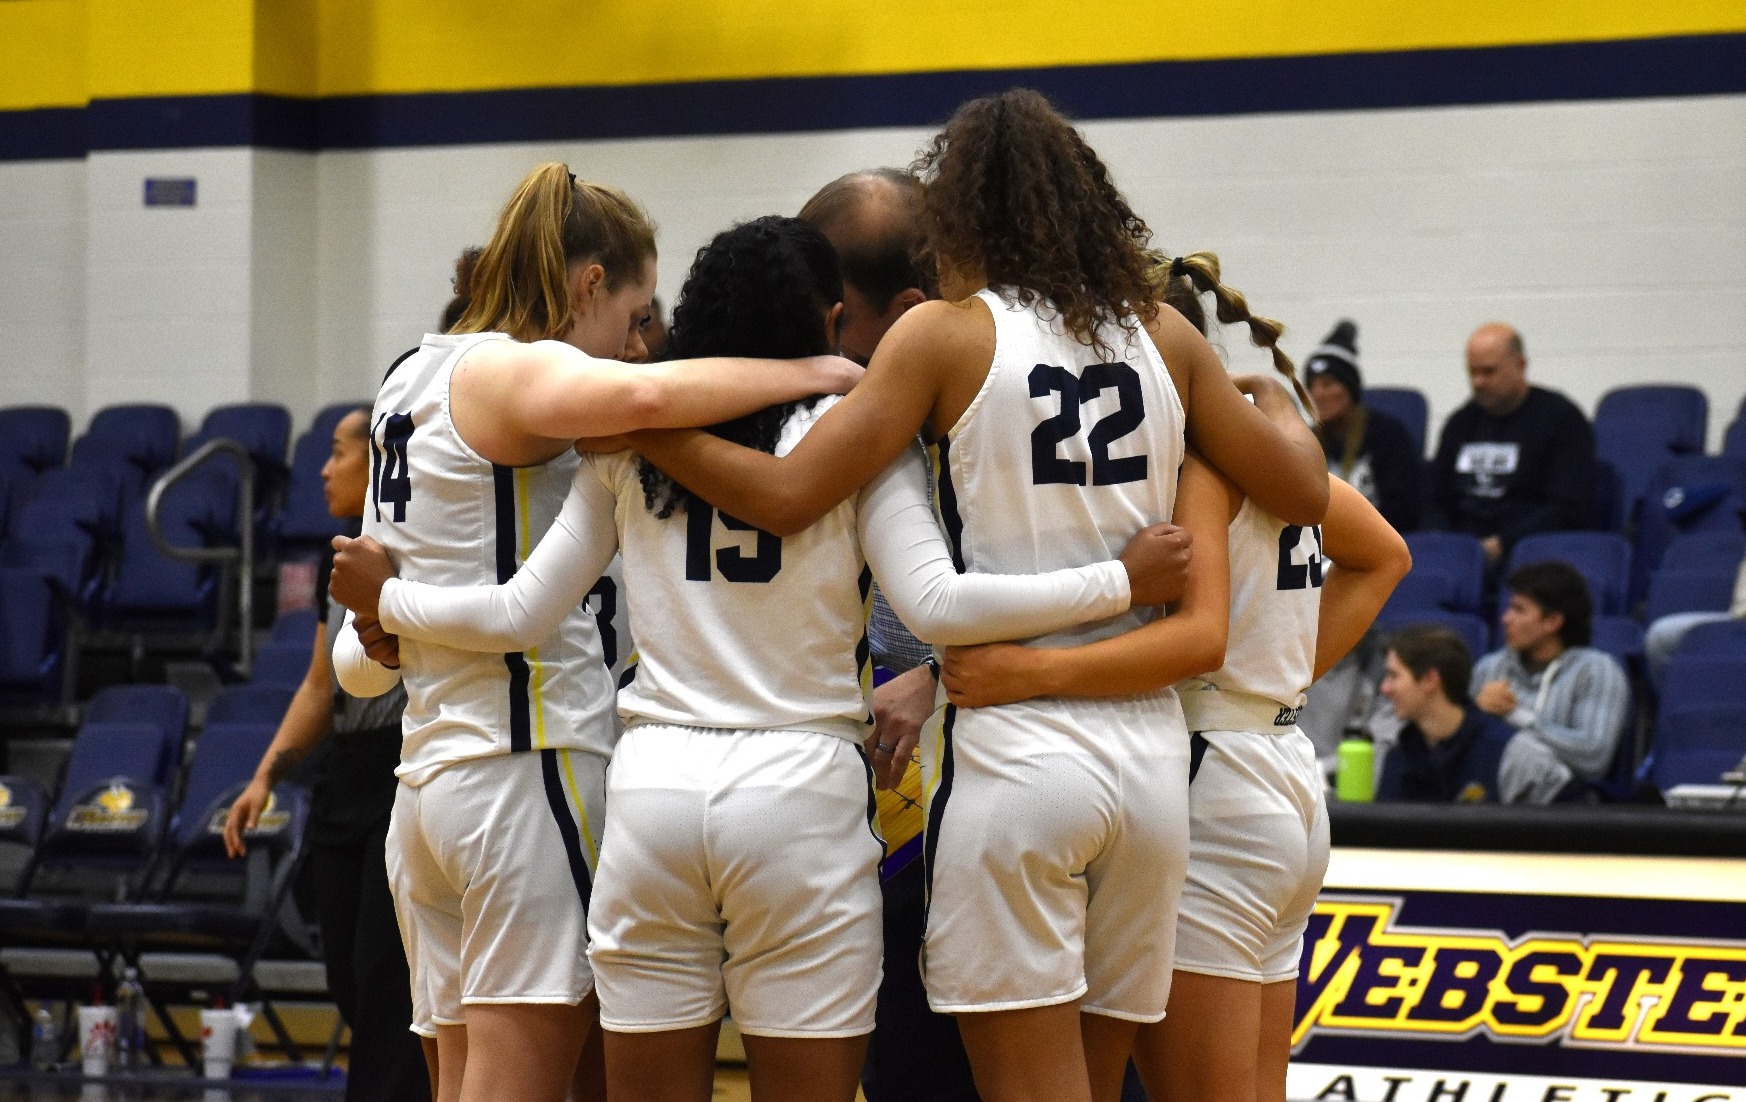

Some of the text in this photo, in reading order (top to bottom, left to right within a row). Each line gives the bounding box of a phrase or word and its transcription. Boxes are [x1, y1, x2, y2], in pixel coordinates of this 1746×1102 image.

[371, 410, 415, 522] 14
[1028, 362, 1148, 486] 22
[1291, 902, 1746, 1047] EBSTE
